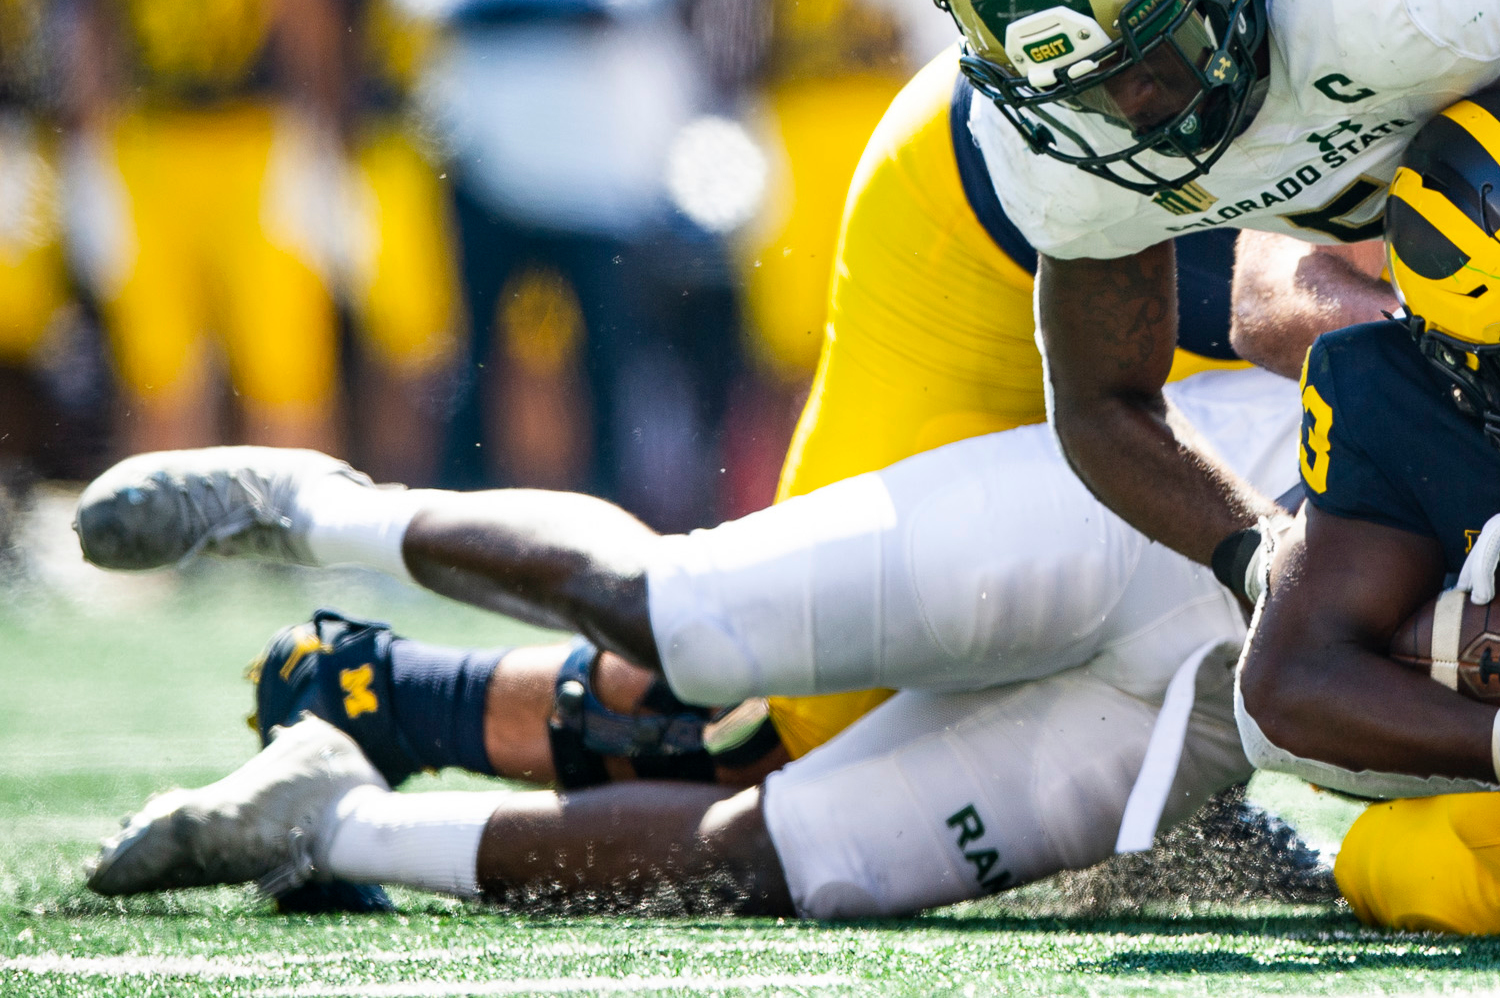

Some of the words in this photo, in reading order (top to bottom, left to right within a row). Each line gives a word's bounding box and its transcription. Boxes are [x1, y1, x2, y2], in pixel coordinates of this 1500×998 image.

[1029, 38, 1067, 63] GRIT
[1314, 73, 1376, 103] C
[339, 663, 378, 719] M
